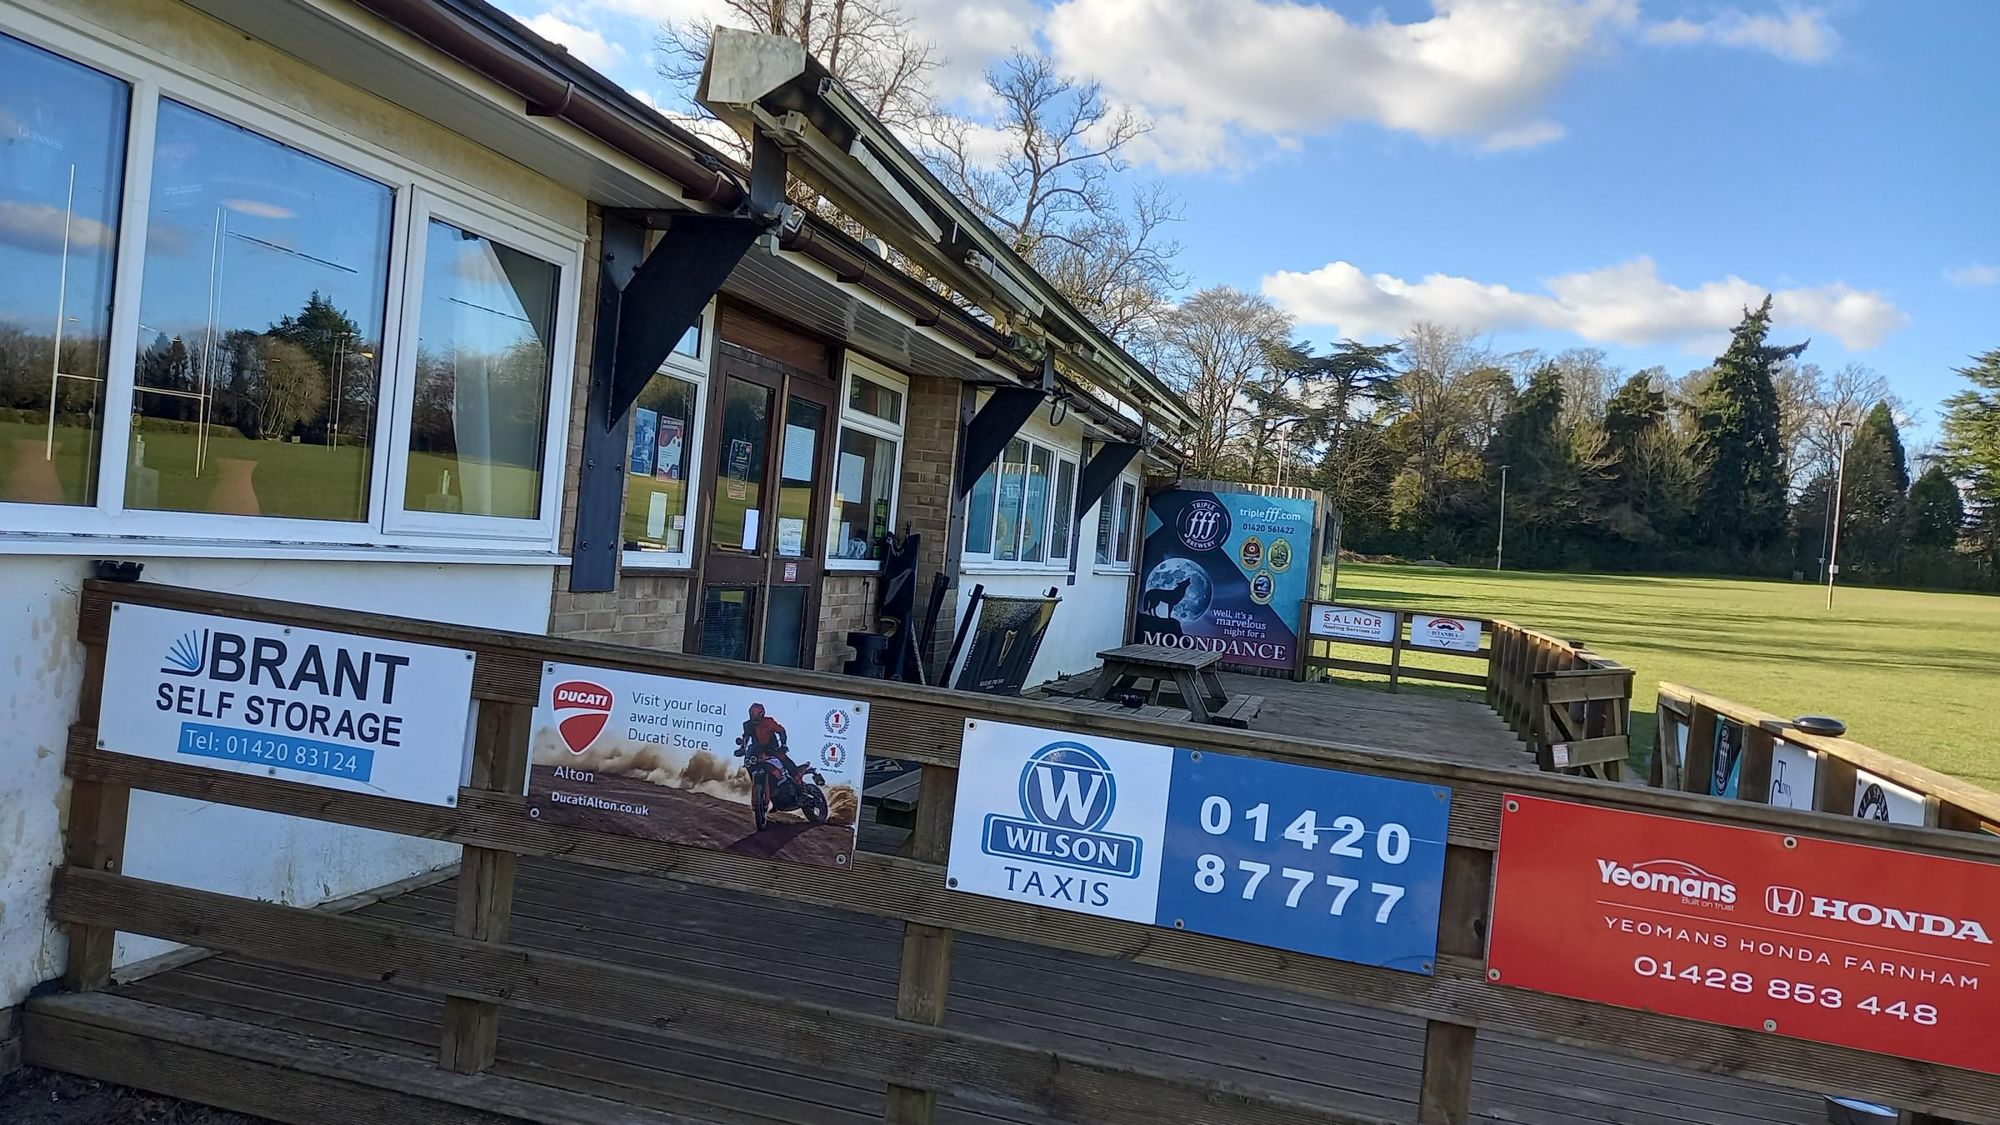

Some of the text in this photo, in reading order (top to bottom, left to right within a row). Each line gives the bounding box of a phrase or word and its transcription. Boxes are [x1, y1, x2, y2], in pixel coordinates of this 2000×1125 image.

[1192, 501, 1216, 512] TRIPLE
[1240, 507, 1301, 523] triplefff.com
[1184, 511, 1221, 539] fff
[1242, 523, 1295, 534] 01420 561422
[1186, 538, 1216, 547] BREWERY
[1213, 609, 1233, 619] Well,
[1235, 611, 1247, 620] it's
[1216, 618, 1267, 630] marvelous
[1323, 613, 1382, 628] SALNOR
[1143, 631, 1286, 661] MOONDANCE
[1224, 627, 1246, 638] night
[1247, 630, 1259, 639] for
[209, 631, 410, 705] BRANT
[557, 688, 608, 706] DUCATI
[631, 691, 727, 716] Visit your local
[156, 682, 403, 747] SELF STORAGE
[629, 711, 724, 737] award winning
[186, 729, 357, 773] Tel: 01420 83124
[628, 727, 712, 751] Ducati Store.
[554, 765, 595, 783] Alton
[551, 791, 650, 816] DucatiAlton.co.uk
[1035, 764, 1104, 827] W
[1200, 795, 1411, 865] 01420
[1005, 824, 1120, 867] WILSON
[1003, 865, 1110, 907] TAXIS
[1193, 853, 1405, 925] 87777
[1597, 858, 1737, 904] Yeomans
[1681, 896, 1735, 912] Built on trust
[1810, 895, 1993, 945] HONDA
[1604, 916, 1979, 991] YEOMANS HONDA FARNHAM
[1633, 955, 1938, 1026] 01428 853 448
